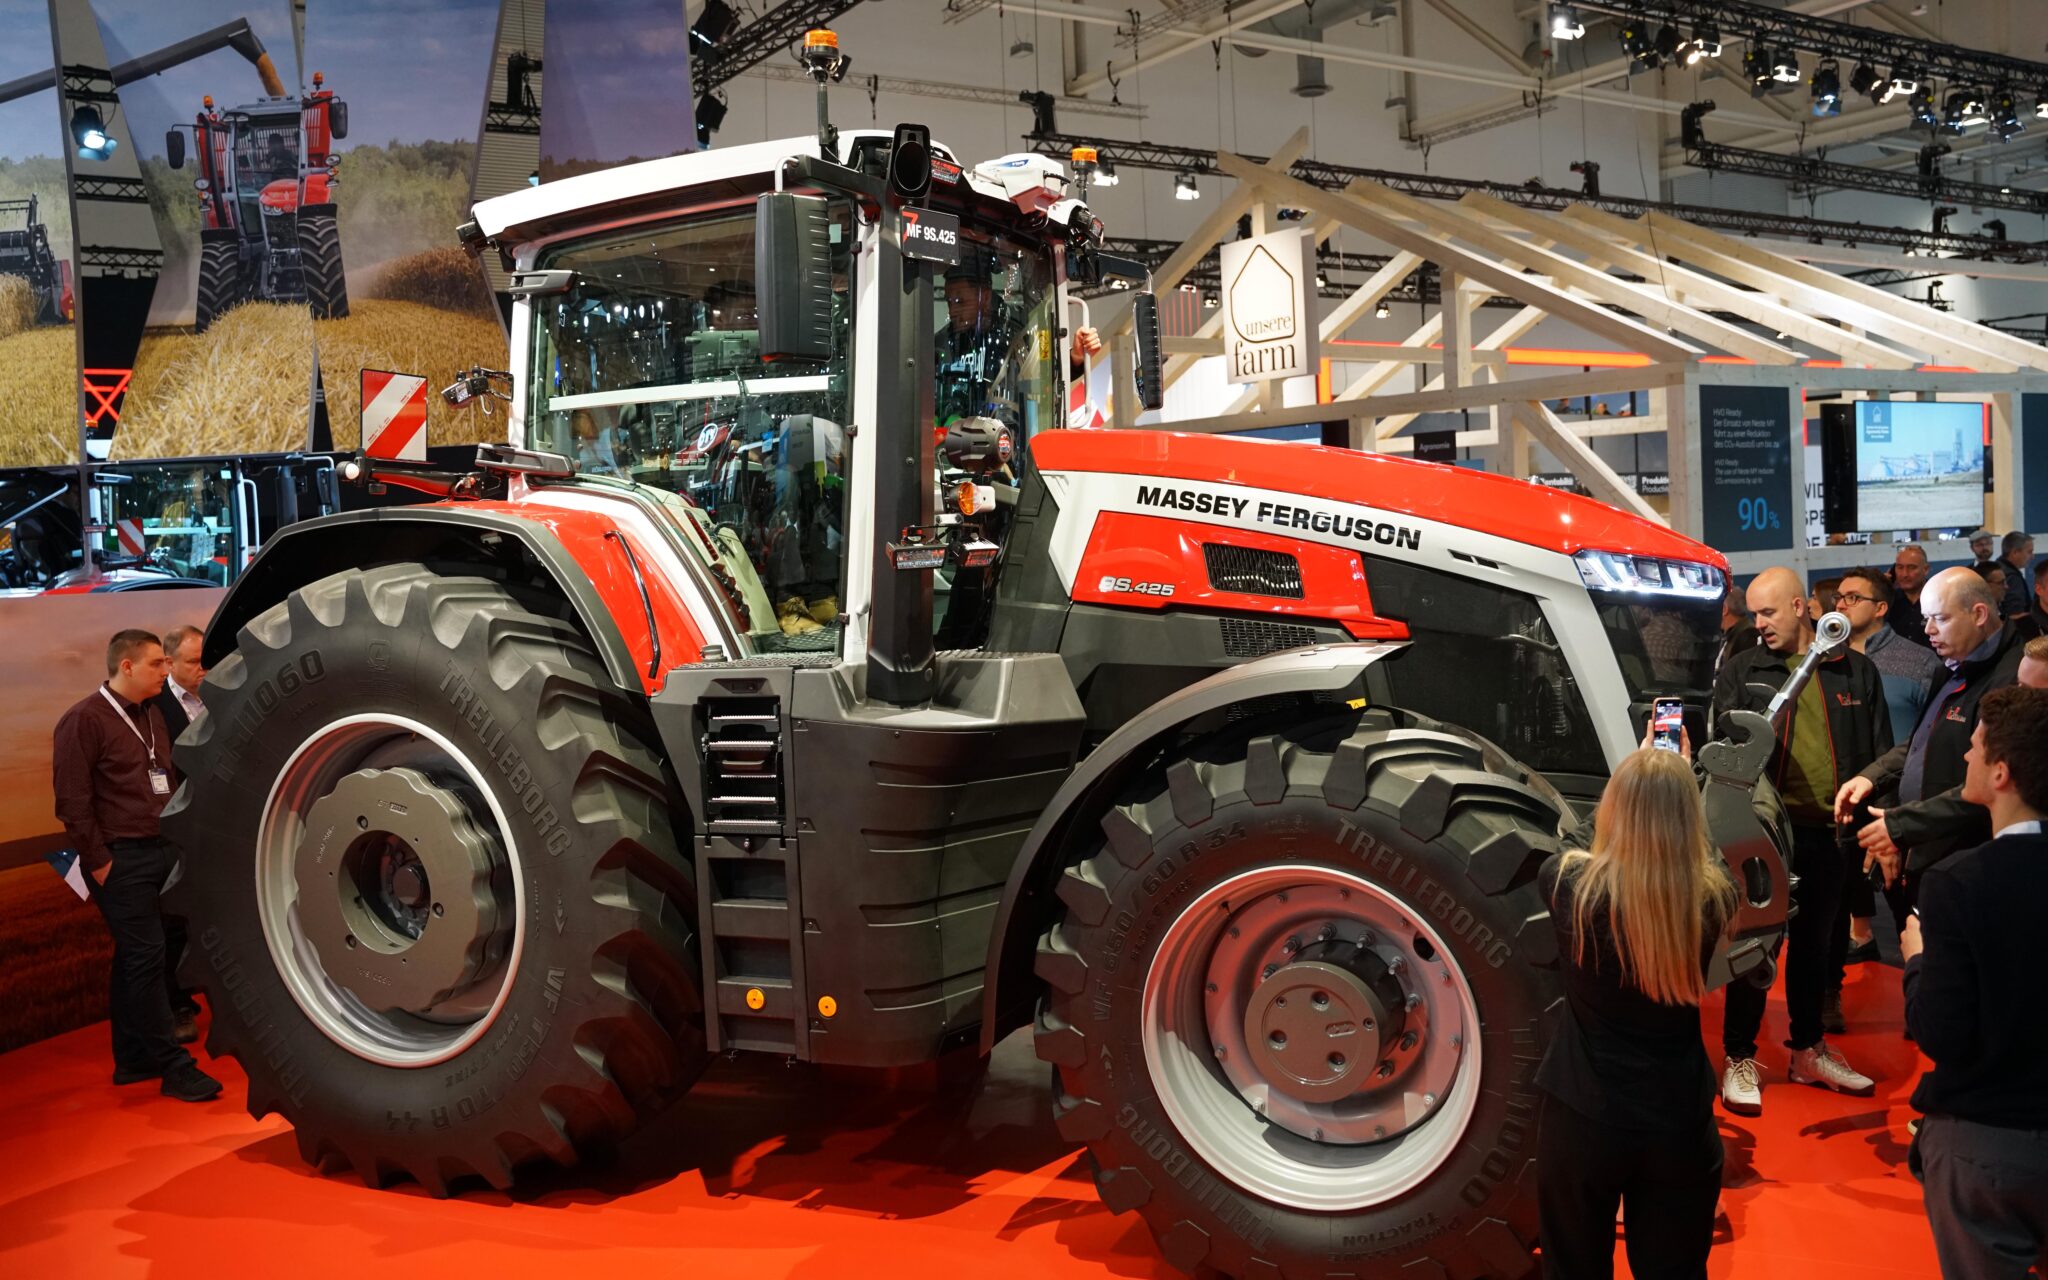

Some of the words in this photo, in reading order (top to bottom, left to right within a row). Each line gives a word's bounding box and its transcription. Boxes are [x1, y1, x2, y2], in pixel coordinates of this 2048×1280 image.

[906, 222, 921, 239] MF
[923, 226, 956, 245] 9S.425
[1246, 315, 1291, 336] unsere
[1234, 341, 1297, 377] farm
[1136, 485, 1250, 518] MASSEY
[1256, 501, 1422, 551] FERGUSON
[440, 658, 573, 858] TRELLEBORG
[1334, 816, 1514, 969] TRELLEBORG
[200, 924, 313, 1111] TRELLEBORG
[543, 966, 567, 1015] VF
[1114, 1102, 1274, 1255] TRELLEBORG
[1342, 1212, 1441, 1247] TRACTION
